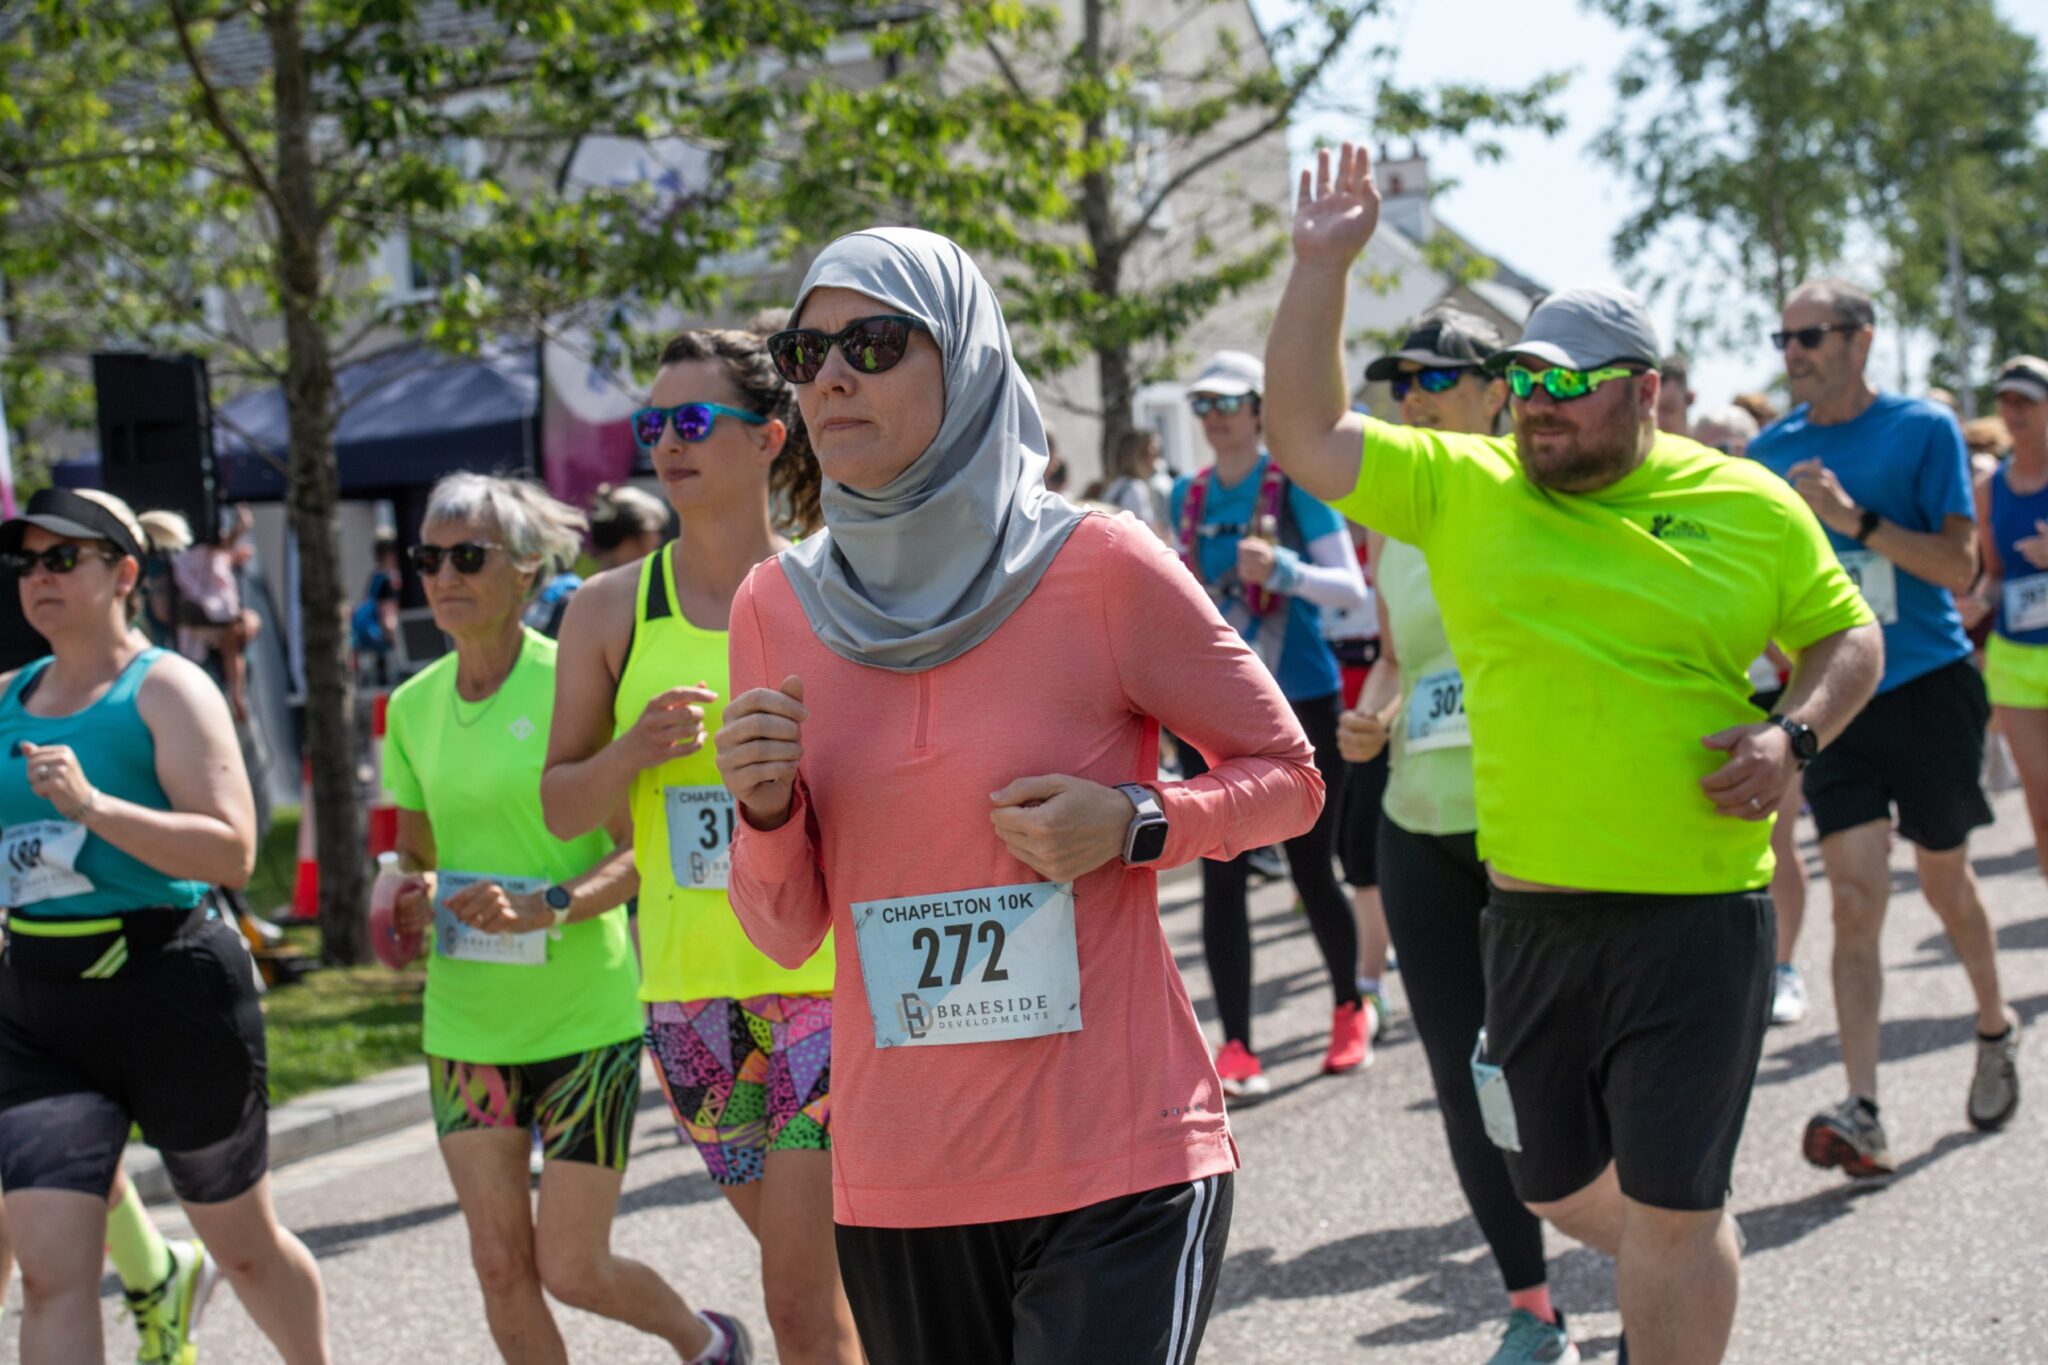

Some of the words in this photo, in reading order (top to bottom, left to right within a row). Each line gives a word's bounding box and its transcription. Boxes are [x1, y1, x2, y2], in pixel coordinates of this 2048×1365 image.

[882, 897, 991, 924] CHAPELTON
[997, 892, 1034, 911] 10K
[912, 919, 1009, 989] 272
[937, 994, 1048, 1019] BRAESIDE
[938, 1011, 1049, 1029] DEVELOPMENTS
